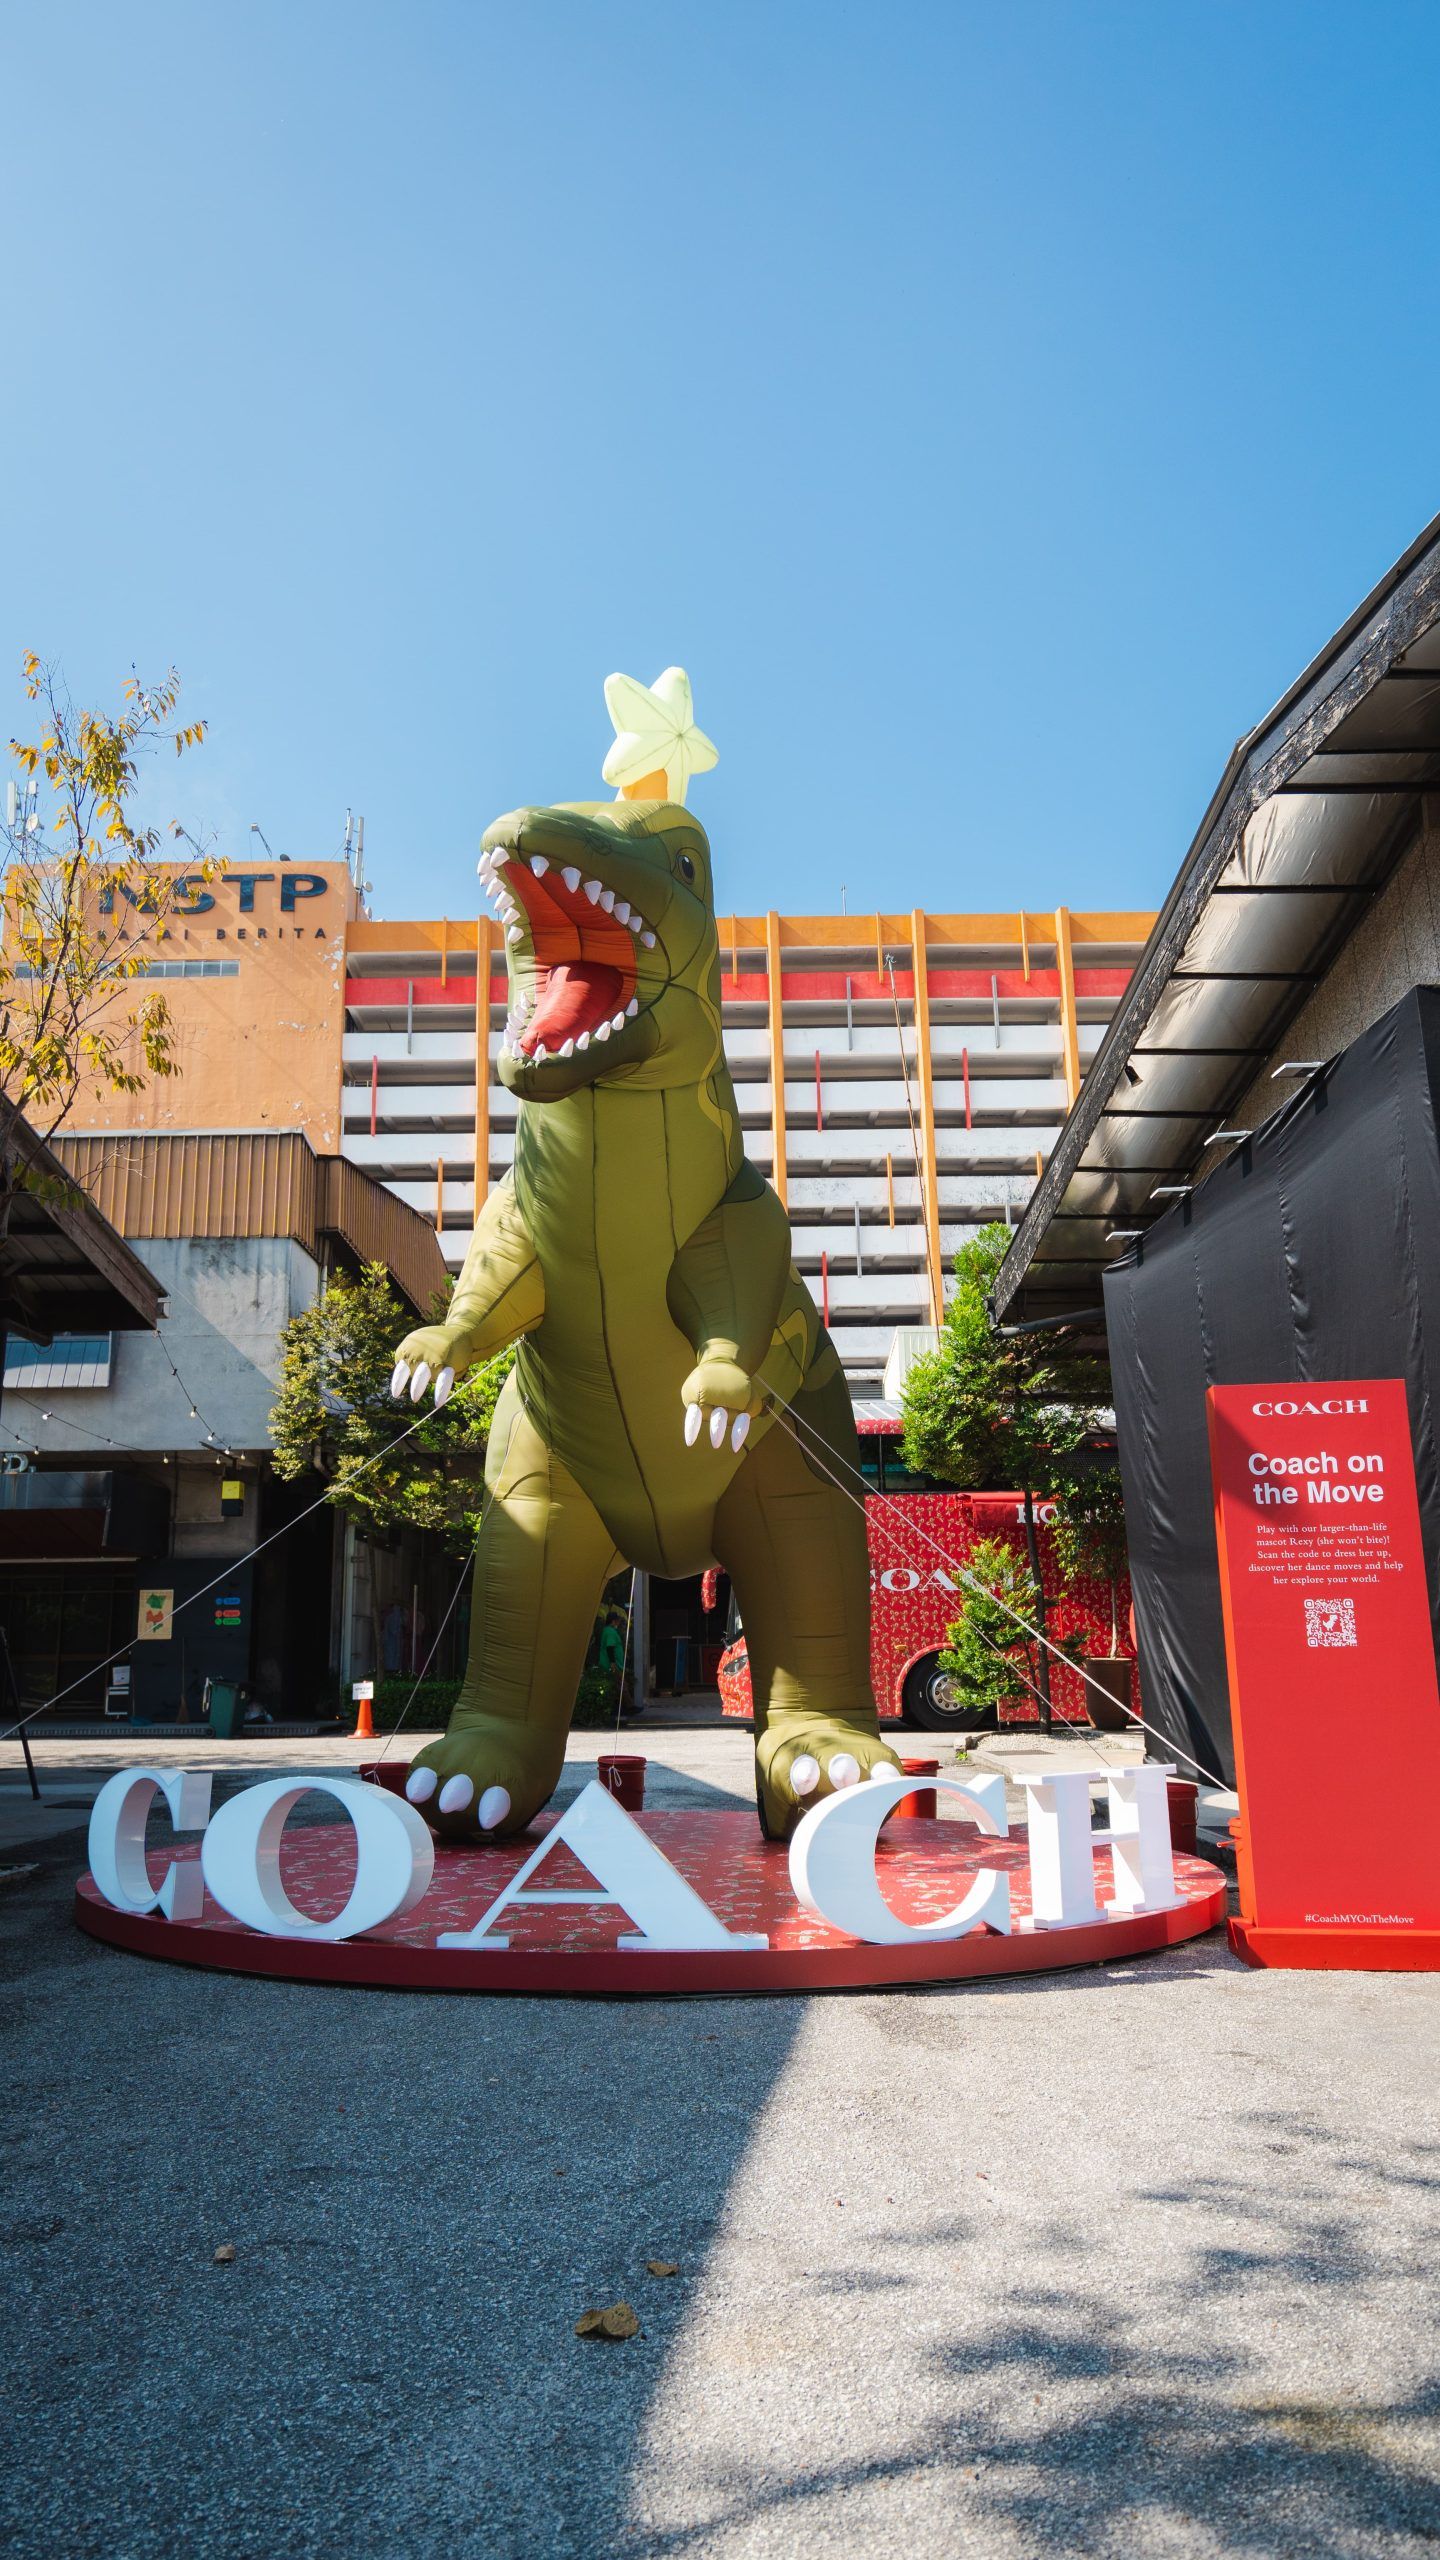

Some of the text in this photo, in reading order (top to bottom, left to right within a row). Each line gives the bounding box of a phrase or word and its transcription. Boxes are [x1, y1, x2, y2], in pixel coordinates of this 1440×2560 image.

[98, 873, 328, 914] NSTP
[216, 927, 327, 940] BERITA
[1252, 1400, 1369, 1416] COACH
[1248, 1451, 1383, 1475] Coach on
[1253, 1481, 1384, 1504] the Move
[1256, 1524, 1276, 1536] Play
[1278, 1524, 1299, 1533] with
[1319, 1522, 1388, 1535] larger-than-life
[1255, 1535, 1390, 1548] mascot Rexy (she won't bite)!
[1257, 1550, 1279, 1559] Scan
[1280, 1549, 1296, 1559] the
[1297, 1549, 1319, 1558] code
[1334, 1548, 1357, 1558] dress
[1358, 1548, 1374, 1557] her
[1376, 1550, 1392, 1559] up,
[1248, 1560, 1404, 1572] discover her dance moves and help
[1272, 1573, 1380, 1587] her explore your world.
[88, 1764, 1187, 1950] COACH
[1304, 1913, 1415, 1924] #CoachMYOnTheMove
